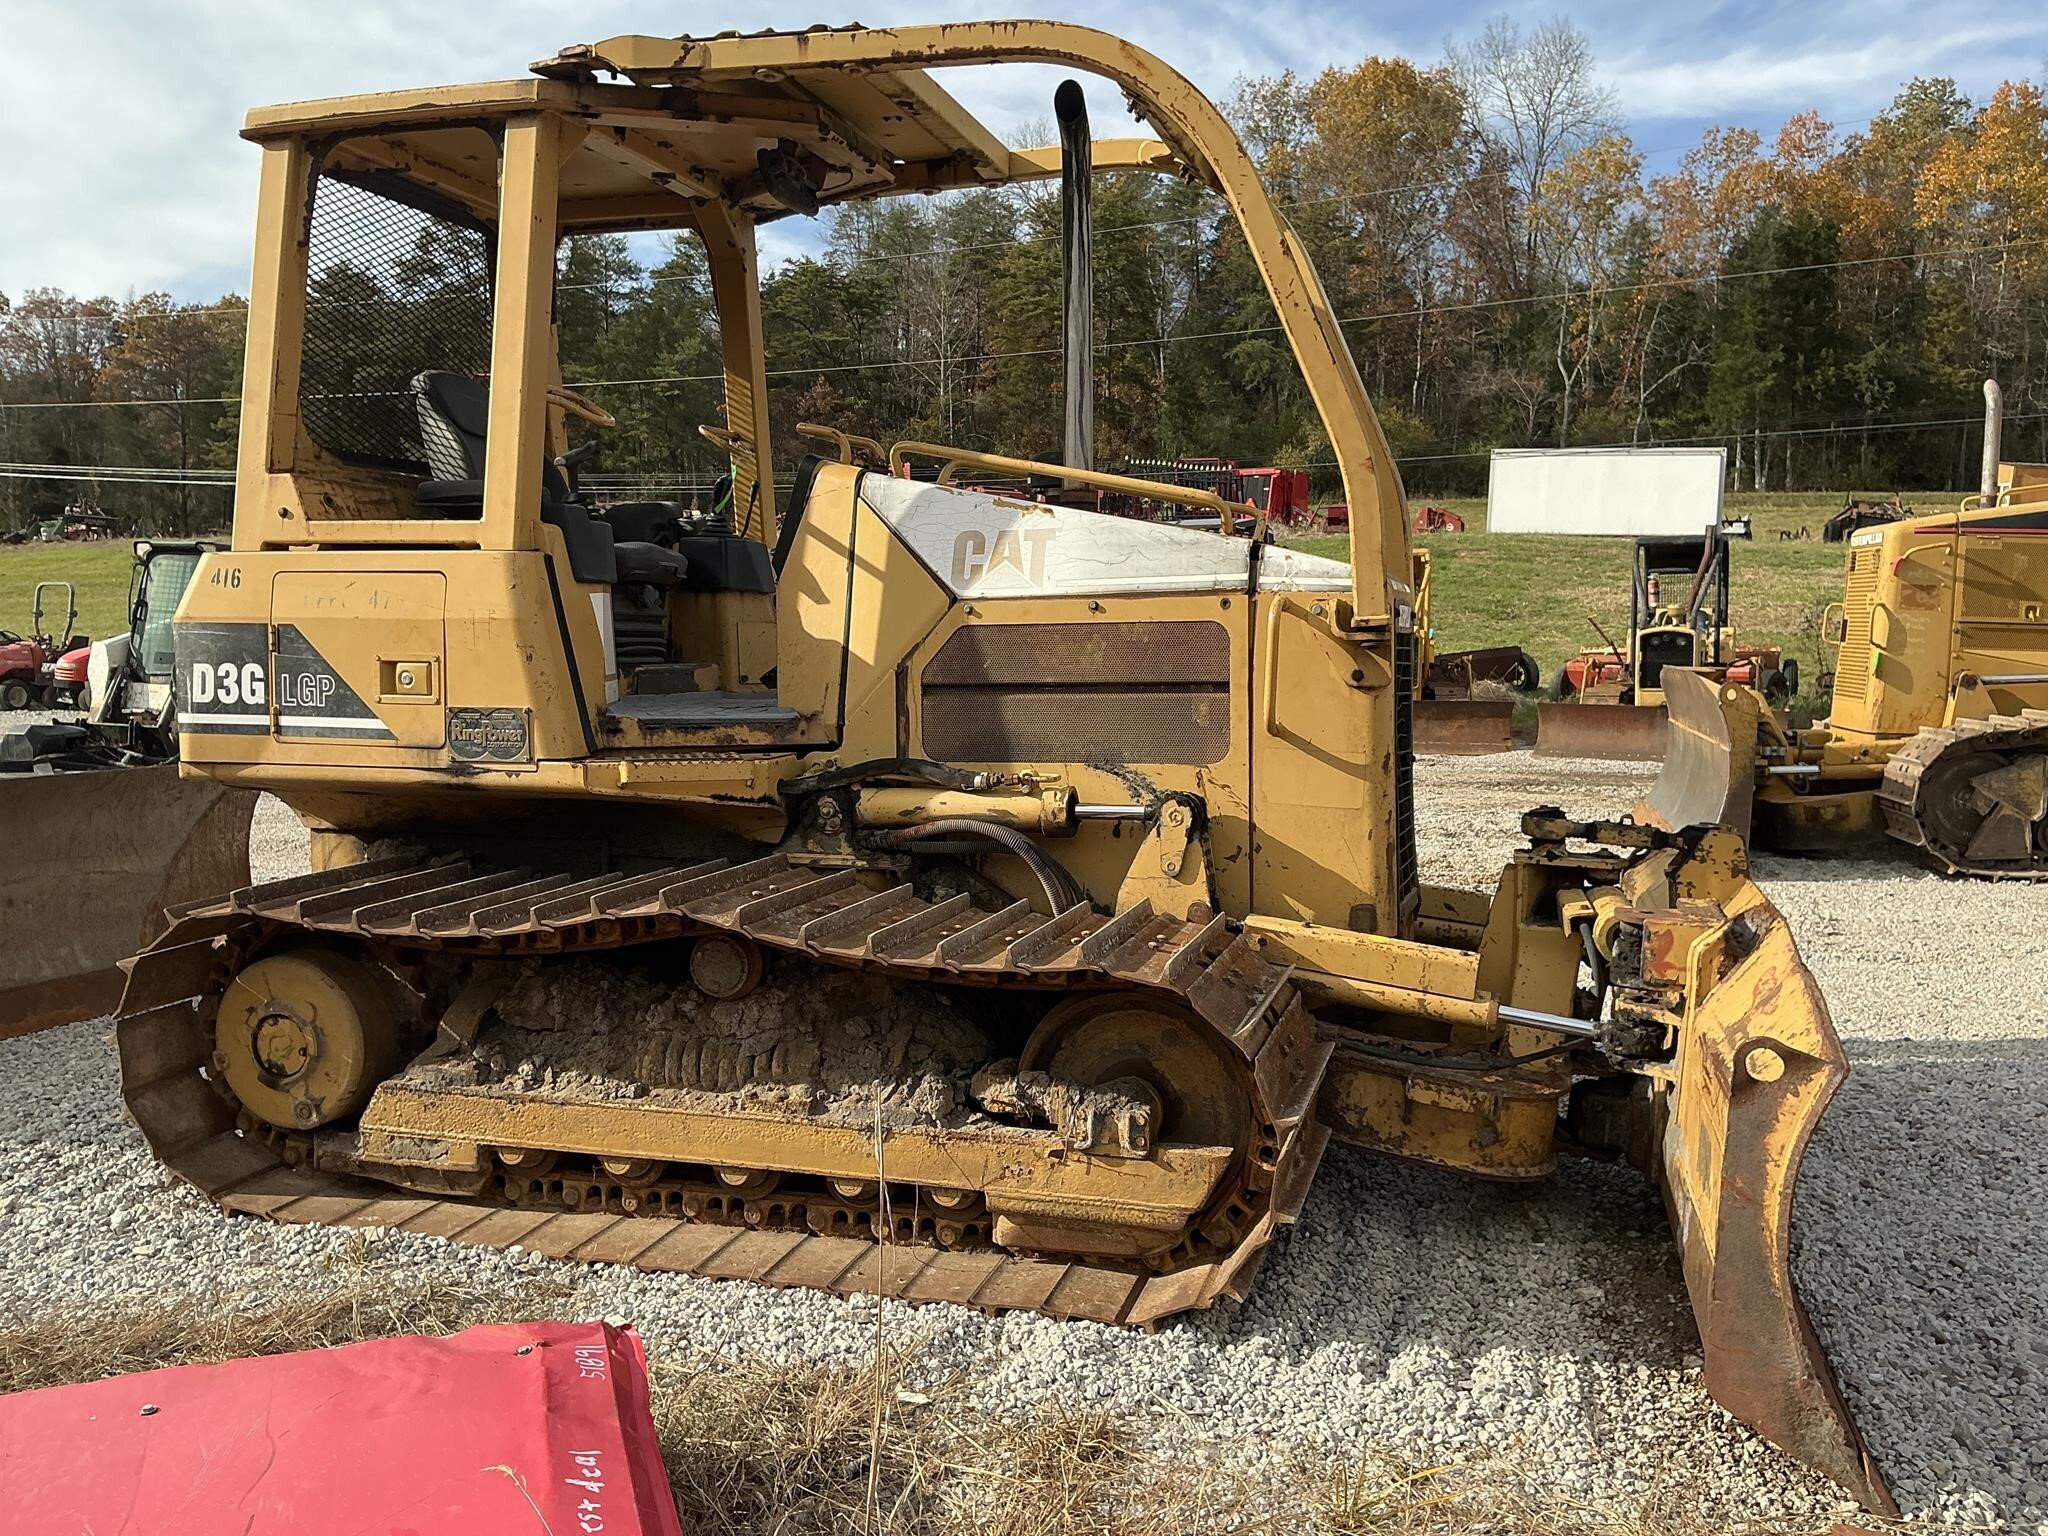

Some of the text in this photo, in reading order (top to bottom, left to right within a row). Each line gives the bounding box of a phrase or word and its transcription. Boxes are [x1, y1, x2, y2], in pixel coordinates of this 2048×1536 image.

[211, 567, 242, 589] 416
[950, 528, 1056, 590] CAT
[192, 662, 336, 707] D3G LGP
[564, 1449, 606, 1494] deal
